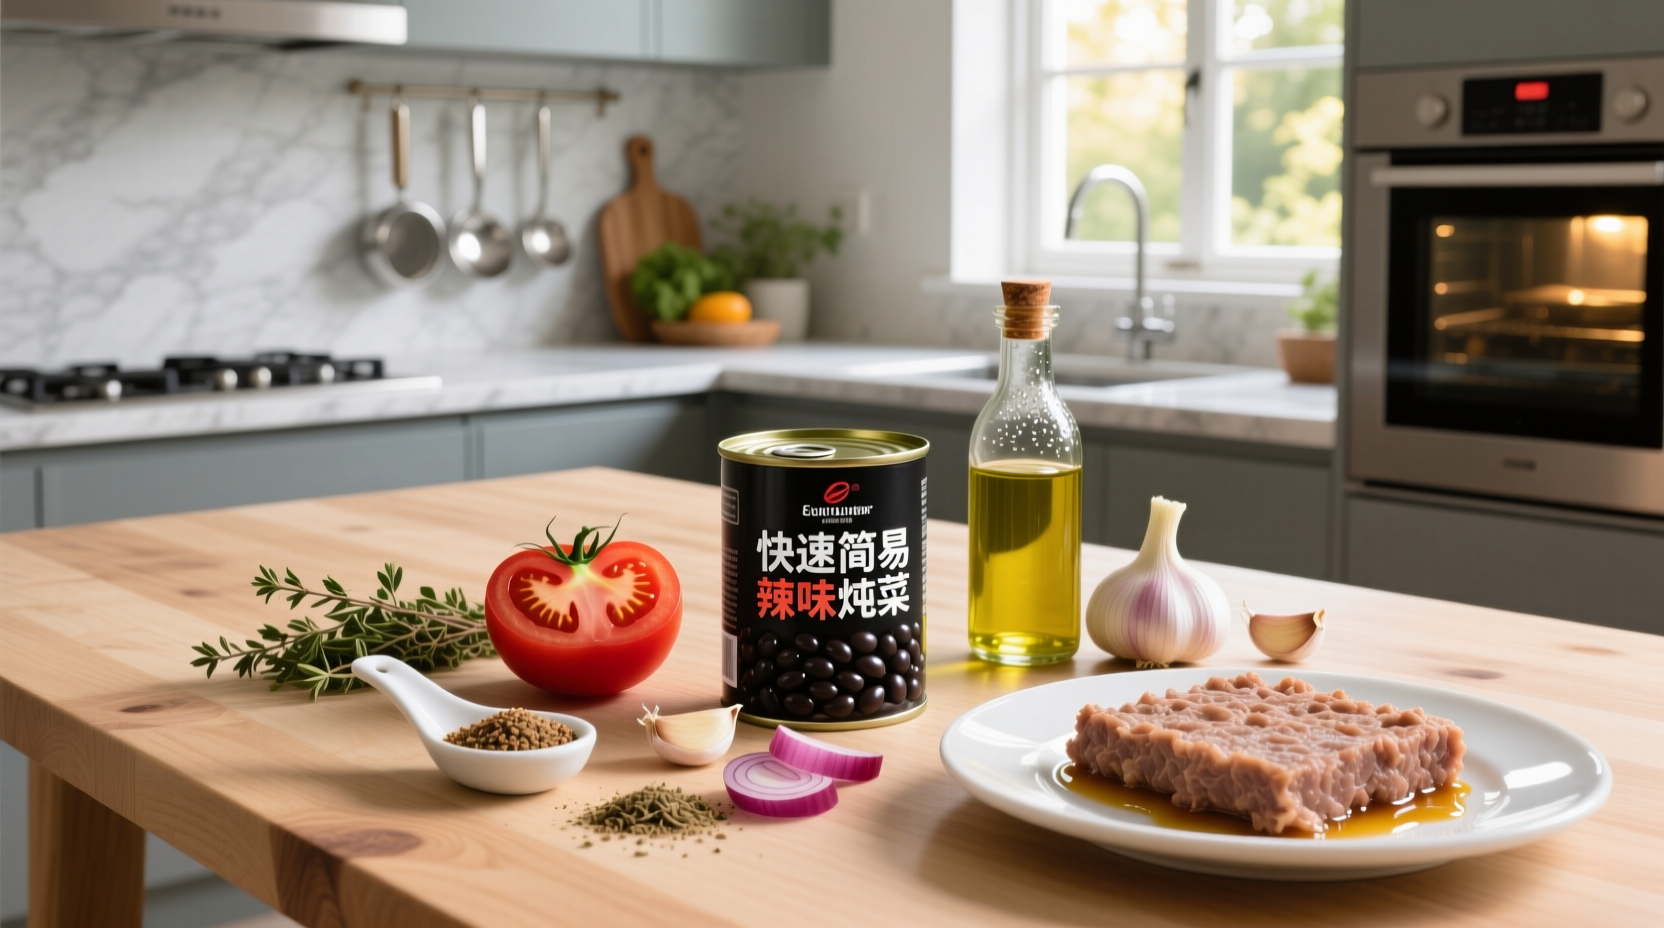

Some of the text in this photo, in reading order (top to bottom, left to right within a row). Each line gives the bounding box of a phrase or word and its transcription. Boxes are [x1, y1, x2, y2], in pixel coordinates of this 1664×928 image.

[756, 527, 910, 574] 快速简易
[756, 572, 910, 621] 辣味炖菜
